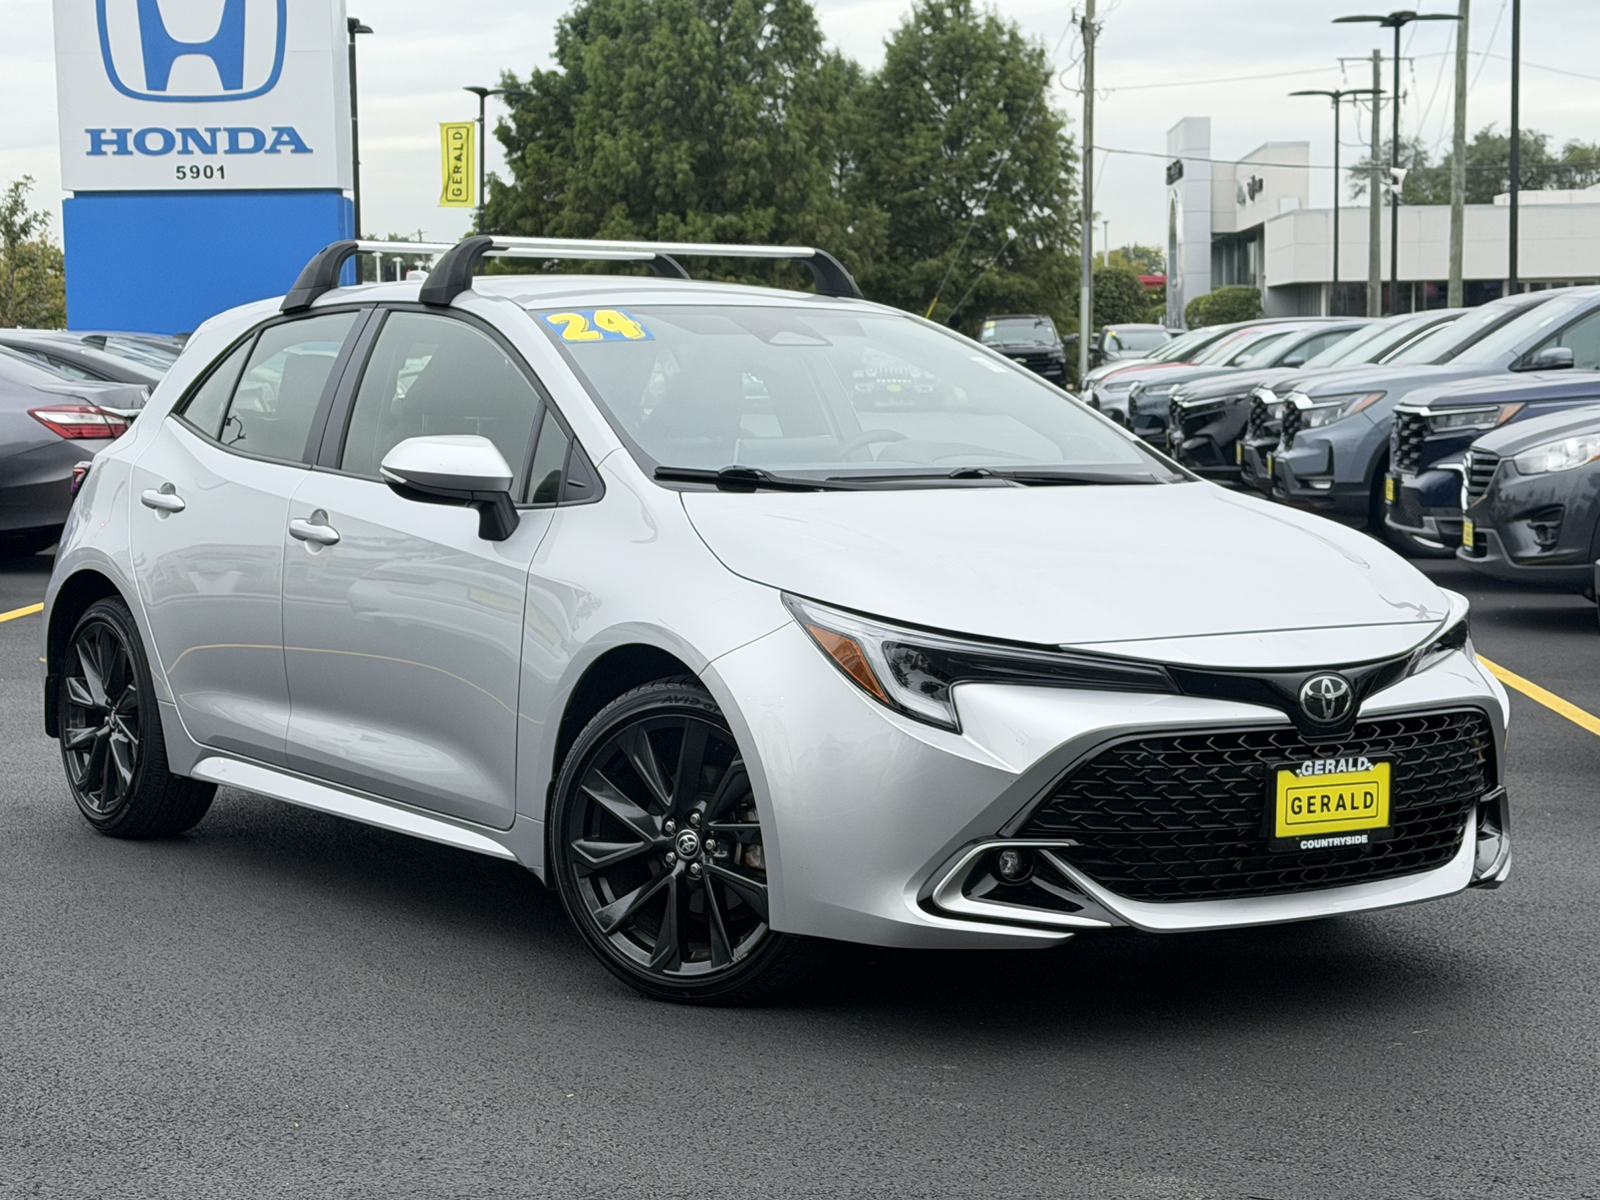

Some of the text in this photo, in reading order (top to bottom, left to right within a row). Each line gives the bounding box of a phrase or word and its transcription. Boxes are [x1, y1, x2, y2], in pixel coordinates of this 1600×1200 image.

[85, 126, 313, 156] HONDA
[176, 164, 226, 180] 5901
[451, 131, 464, 197] GERALD
[546, 309, 647, 342] 24
[1301, 757, 1369, 776] GERALD
[1291, 791, 1374, 816] GERALD
[1300, 834, 1368, 849] COUNTRYSIDE
